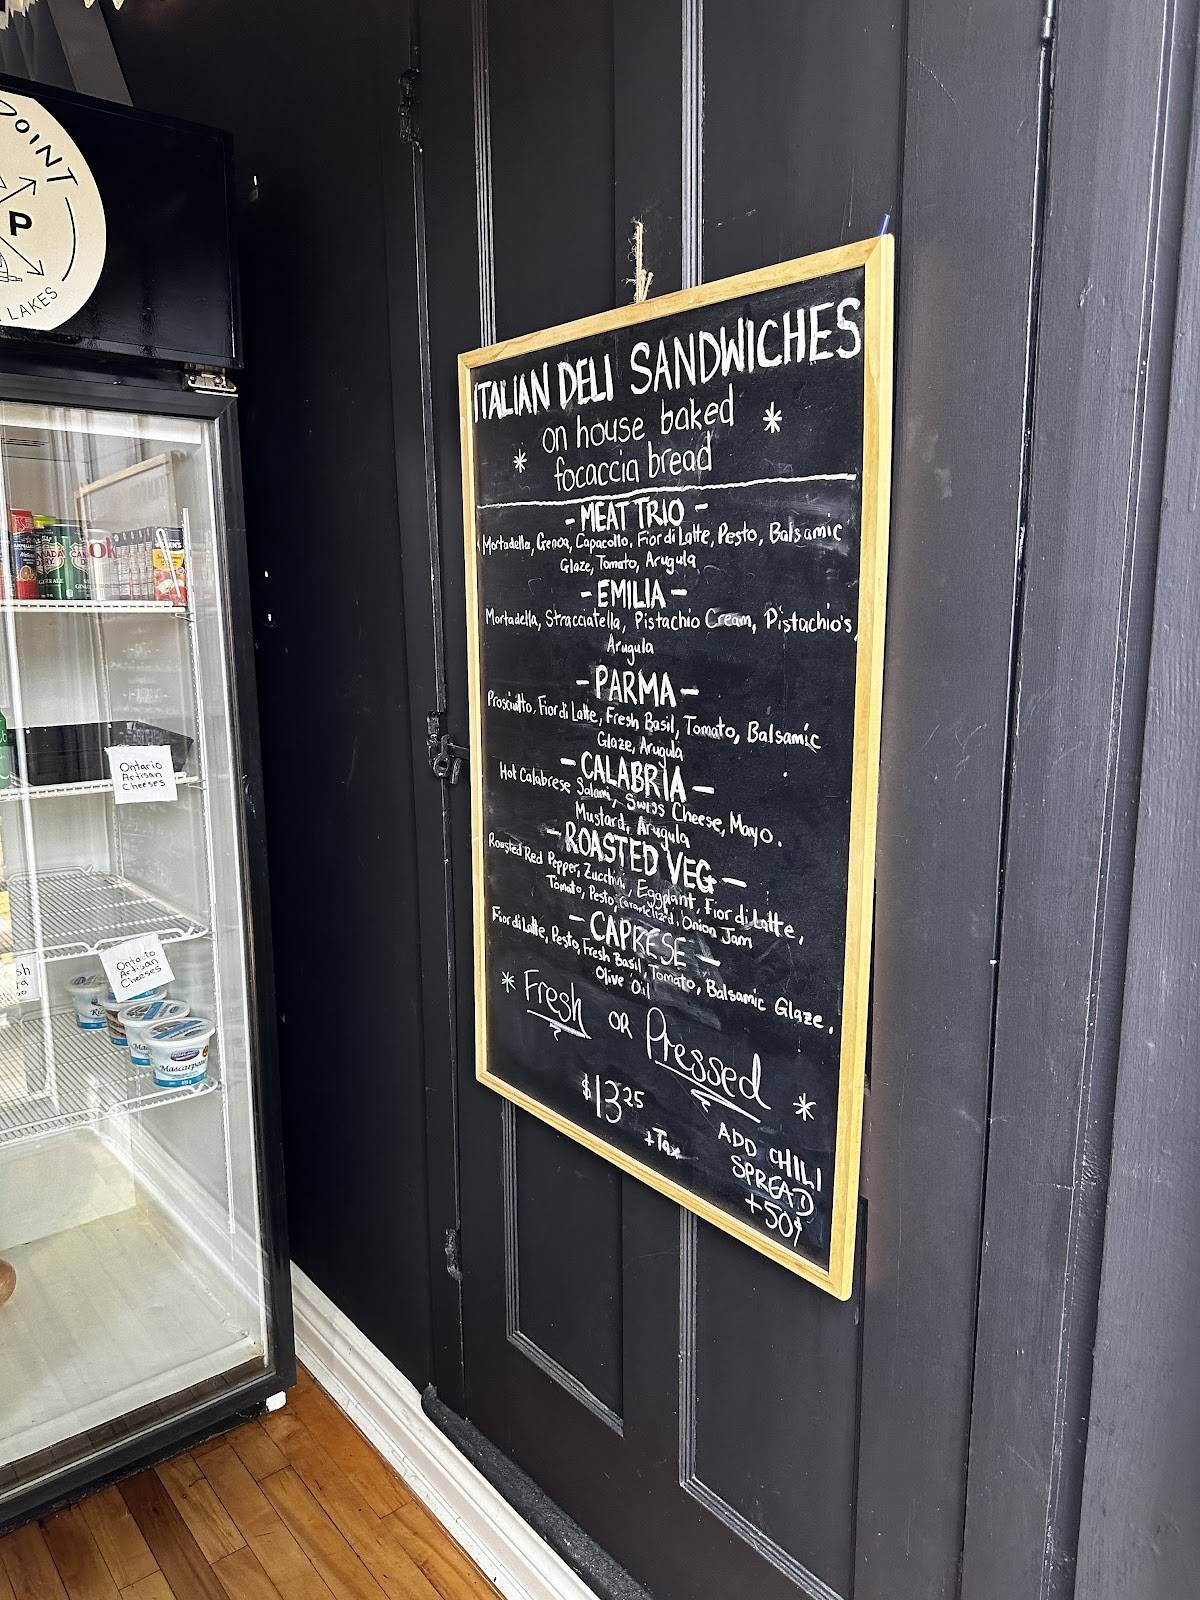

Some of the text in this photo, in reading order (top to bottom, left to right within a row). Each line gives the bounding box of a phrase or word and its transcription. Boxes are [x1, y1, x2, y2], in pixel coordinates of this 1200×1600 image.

[8, 210, 32, 237] P
[6, 286, 58, 321] LAKES
[473, 297, 861, 423] ITALIAN DELI SANDWICHES
[542, 384, 734, 453] on house baked
[554, 431, 713, 492] focaccia bread
[481, 533, 534, 556] Mortadella,
[536, 531, 573, 554] Genoa,
[575, 532, 633, 555] Capacollo,
[678, 524, 714, 548] Latte,
[718, 523, 763, 547] Pesto,
[768, 513, 845, 543] Balsamic
[580, 501, 630, 533] MEAT
[631, 496, 685, 530] TRIO
[559, 552, 697, 577] Glaze, Tomato, Arugula
[597, 579, 667, 610] EMILIA
[485, 607, 541, 631] Mortadella,
[545, 608, 627, 635] Stracciatella,
[634, 608, 700, 631] Pistachio
[705, 611, 757, 634] Cream,
[606, 635, 655, 665] Arugula
[595, 664, 677, 708] PARMA
[597, 730, 684, 770] Glaze, Arugula
[606, 706, 640, 731] Fresh
[644, 711, 681, 741] Basil,
[683, 715, 740, 745] Tomato,
[747, 722, 822, 754] Balsamic
[120, 760, 163, 773] Ontario
[122, 771, 163, 781] Artisan
[122, 779, 166, 791] Cheeses
[580, 750, 687, 803] CALABRIA
[499, 760, 517, 781] Hot
[519, 767, 571, 795] Calabrese
[625, 793, 666, 818] Swiss
[671, 801, 725, 837] Cheese,
[575, 801, 691, 852] Mustard, Arugula
[488, 831, 523, 857] Roasted
[524, 845, 543, 865] Red
[548, 850, 580, 878] Pepper,
[564, 821, 659, 877] ROASTED
[667, 851, 718, 894] VEG
[545, 875, 586, 900] Tomato,
[589, 884, 618, 913] Pesto,
[682, 916, 717, 938] Onion
[721, 926, 753, 949] Jam
[116, 950, 156, 971] Ontario
[589, 911, 687, 967] CAPRESE
[121, 965, 162, 988] Cheeses
[552, 925, 580, 955] Pesto,
[581, 937, 611, 964] Fresh
[613, 950, 648, 980] Basil,
[648, 961, 701, 996] Tomato,
[706, 979, 766, 1011] Balsamic
[595, 966, 652, 1000] Olive Oil
[523, 969, 592, 1039] Fresh
[645, 1006, 772, 1111] Pressed
[718, 1122, 822, 1192] ADD CHILI
[731, 1155, 815, 1217] SPREAD
